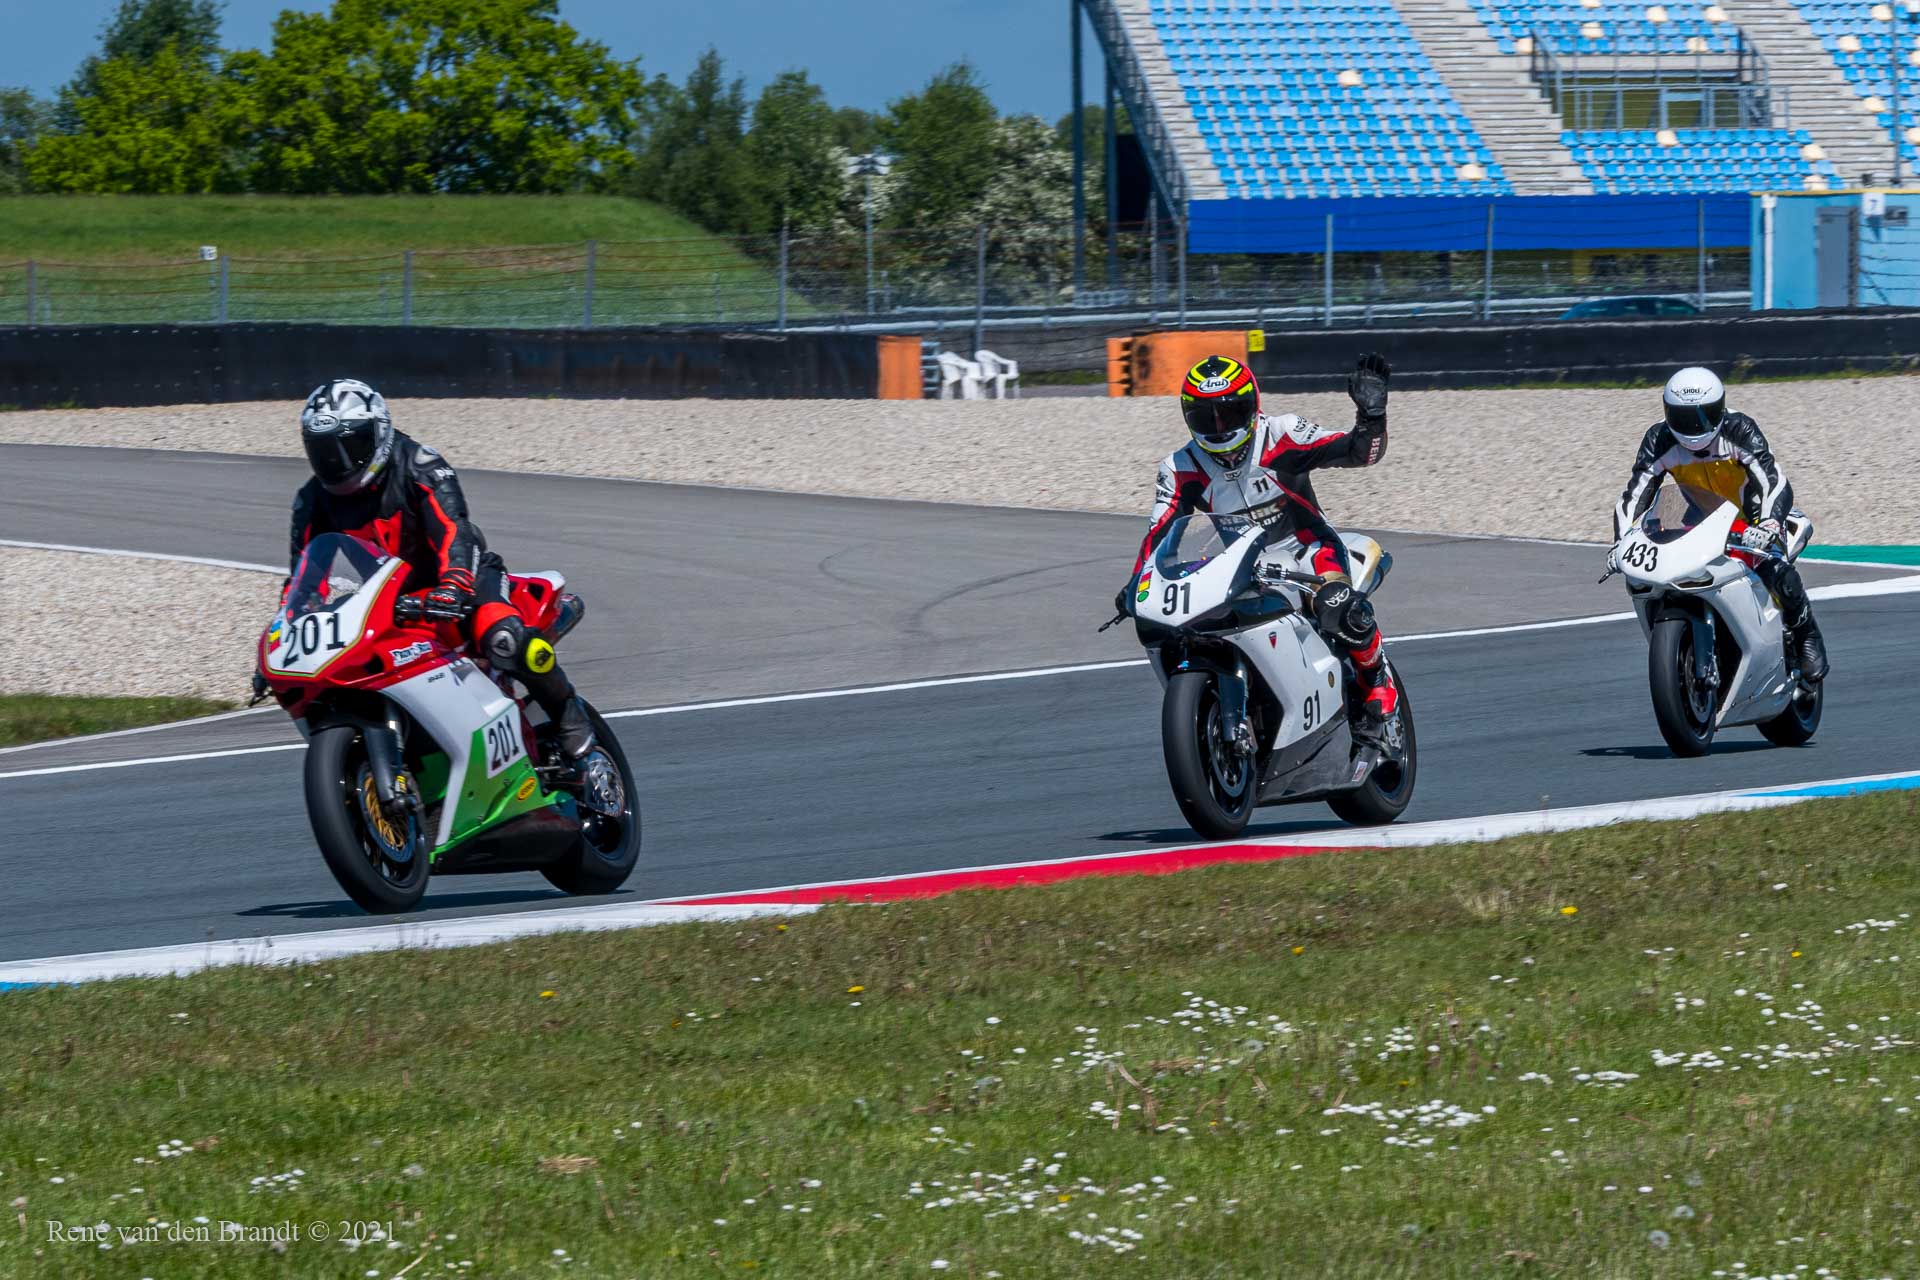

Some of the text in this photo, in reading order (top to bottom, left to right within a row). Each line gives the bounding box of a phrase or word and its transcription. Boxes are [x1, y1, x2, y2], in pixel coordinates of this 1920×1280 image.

[1203, 379, 1225, 388] Arai
[1253, 478, 1269, 493] 11
[1622, 541, 1658, 572] 433
[1162, 582, 1191, 616] 91
[283, 612, 345, 668] 201
[1303, 689, 1320, 731] 91
[488, 714, 520, 771] 201
